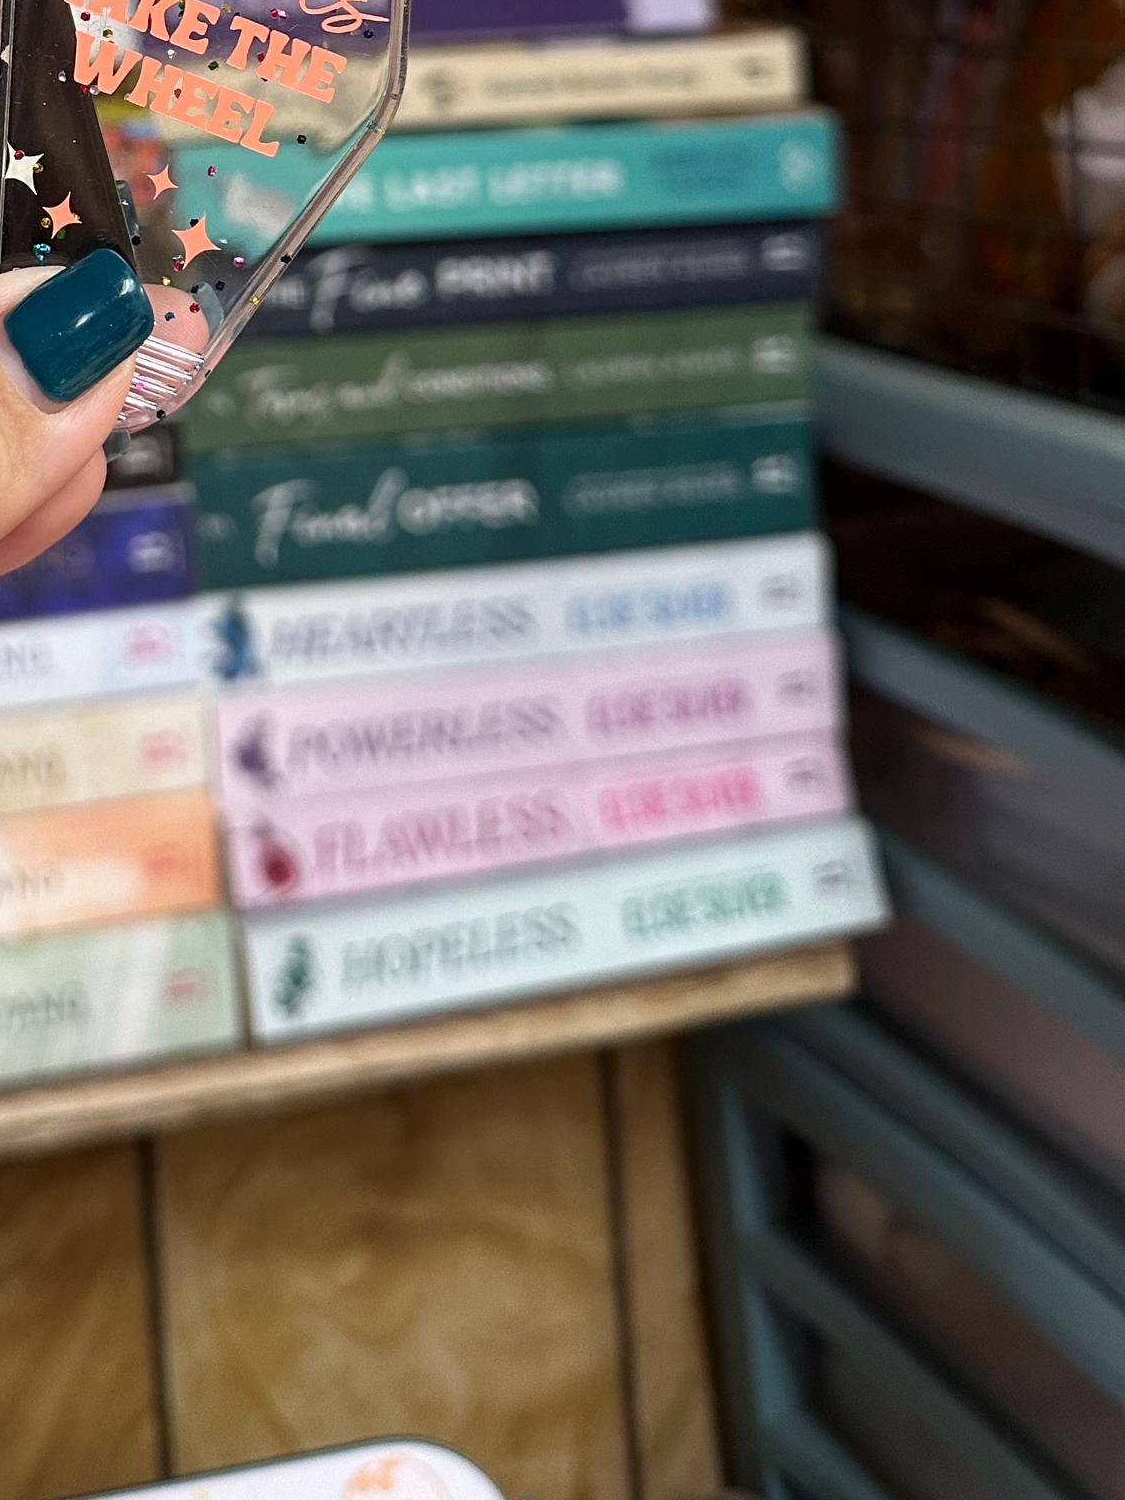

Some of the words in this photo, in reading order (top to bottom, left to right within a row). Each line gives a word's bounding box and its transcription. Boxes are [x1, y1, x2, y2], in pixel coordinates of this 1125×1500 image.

[72, 30, 281, 158] WHEEL
[225, 14, 348, 104] THE
[434, 249, 557, 298] PRINT
